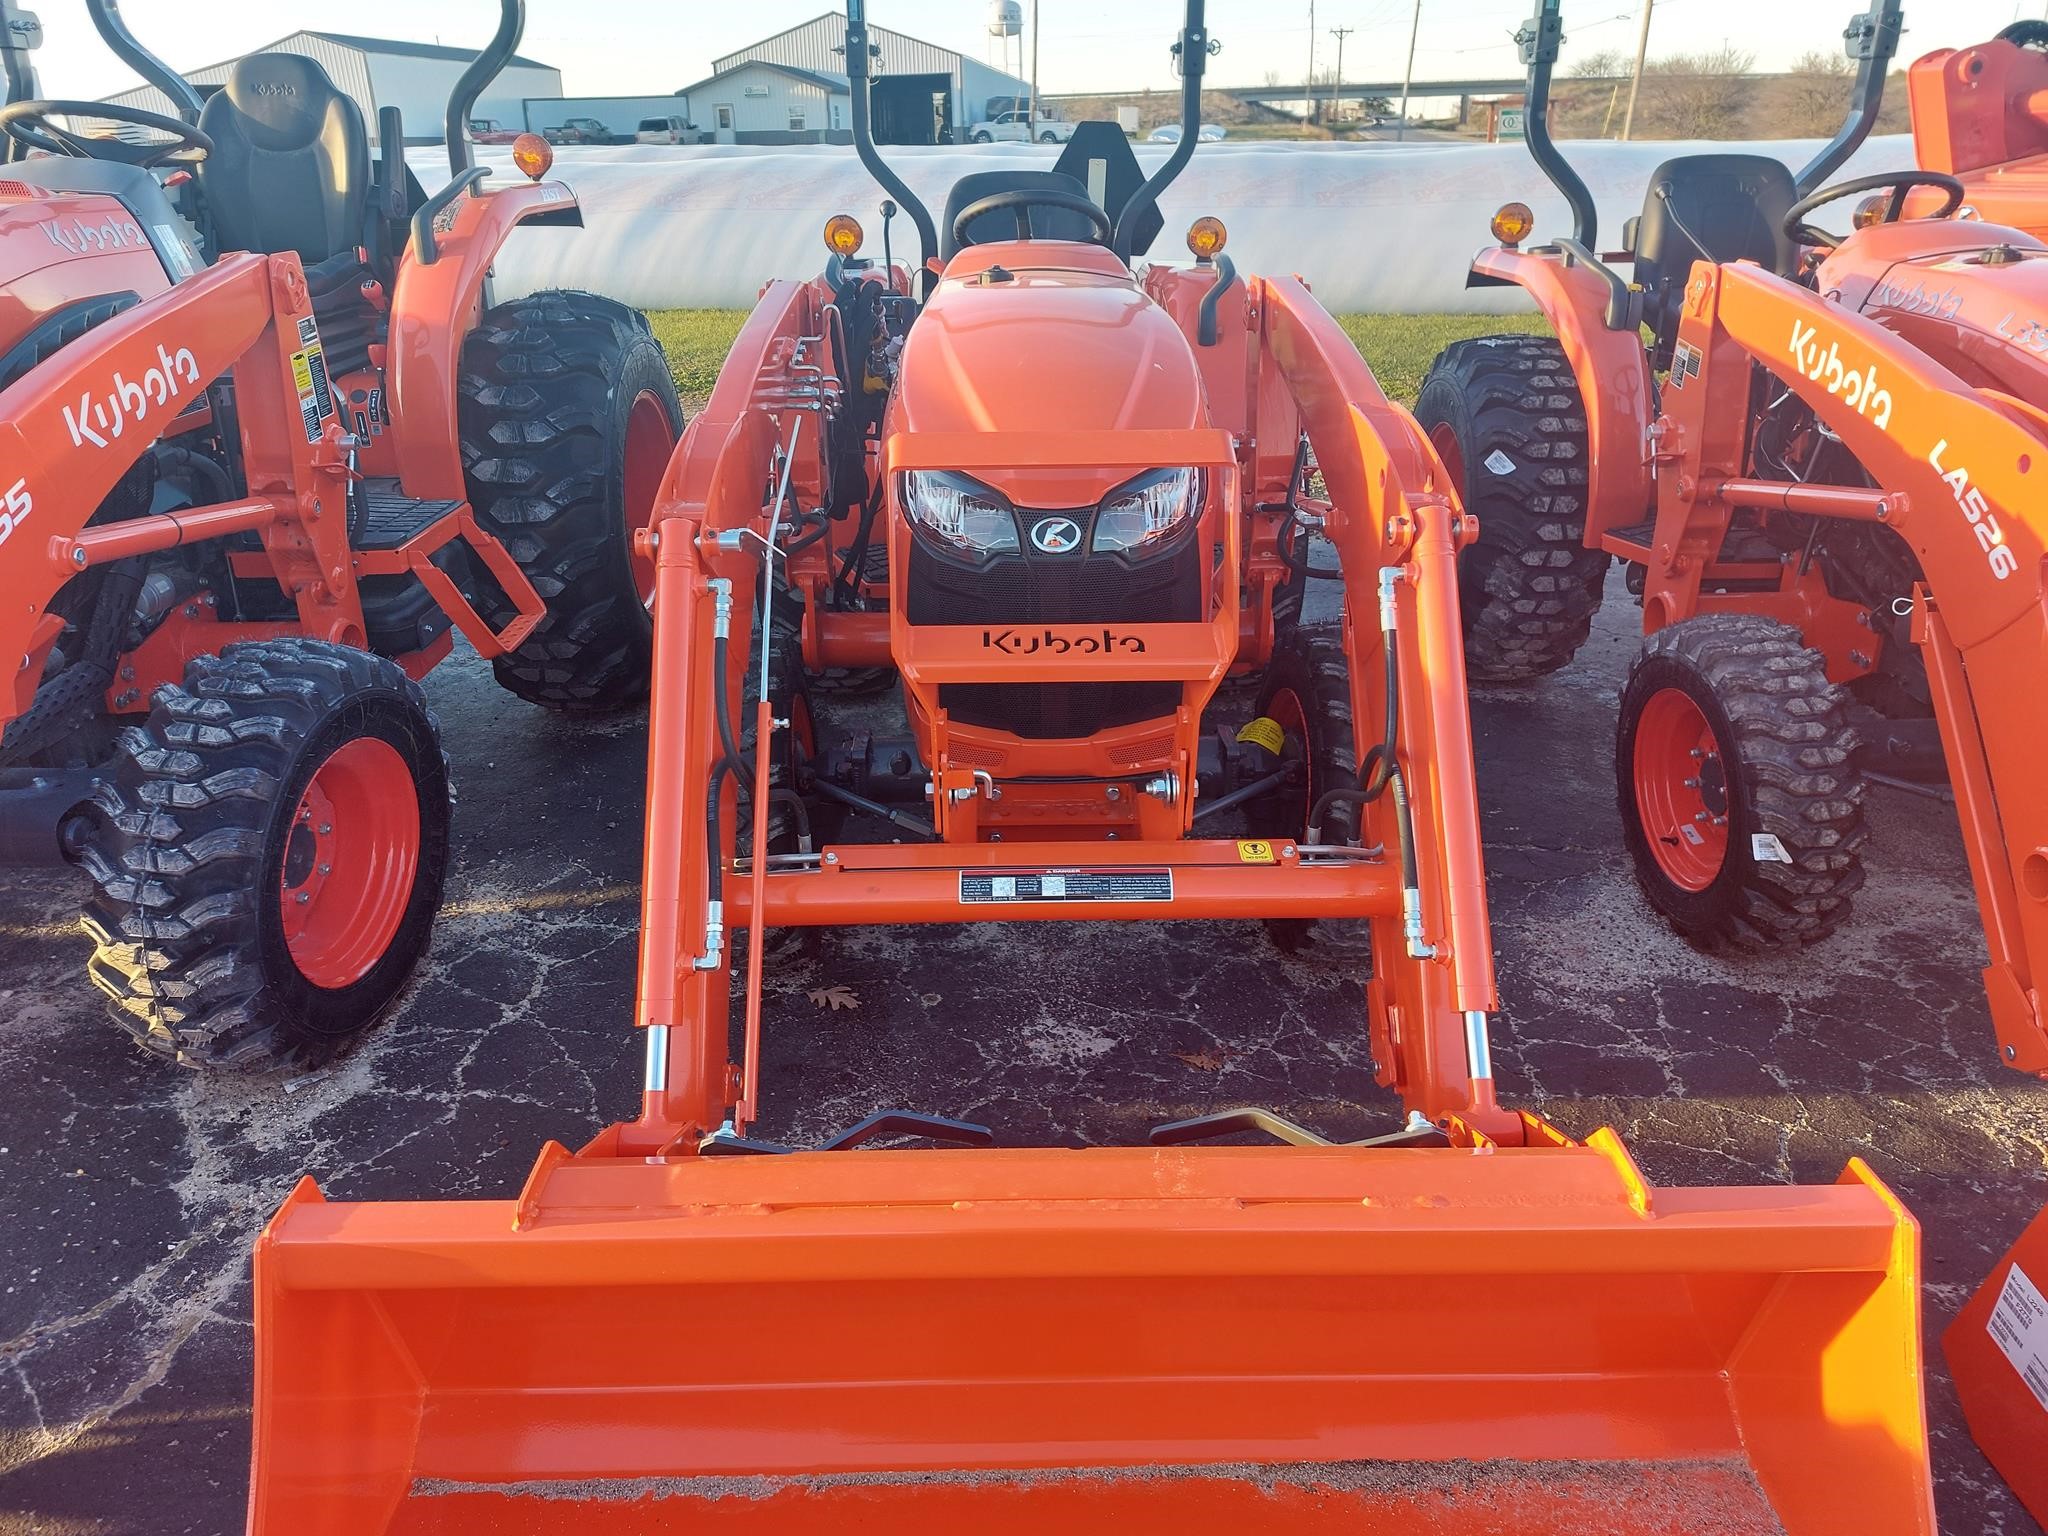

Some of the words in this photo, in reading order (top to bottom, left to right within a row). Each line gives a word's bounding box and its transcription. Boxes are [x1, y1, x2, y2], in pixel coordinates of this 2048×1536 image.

[254, 82, 296, 97] Kubota
[540, 187, 562, 202] HST
[38, 215, 146, 255] Kubota
[1878, 276, 1964, 320] Kubota
[1788, 318, 1893, 431] Kubota
[62, 343, 200, 449] Kubota
[1928, 437, 2019, 581] LA526
[982, 629, 1147, 655] Kubota
